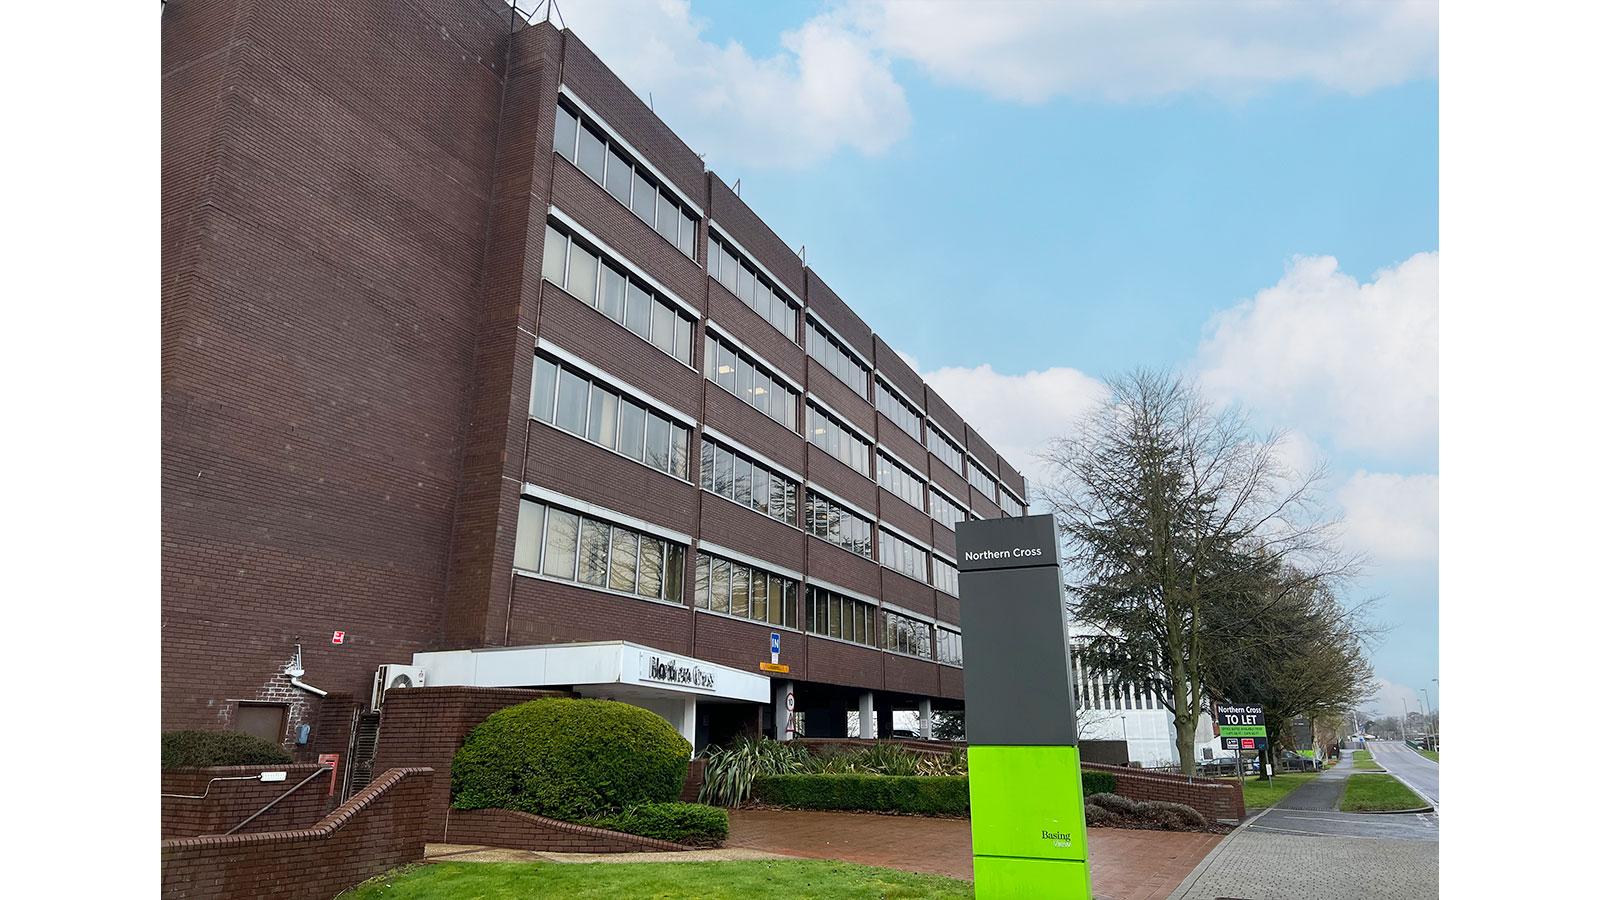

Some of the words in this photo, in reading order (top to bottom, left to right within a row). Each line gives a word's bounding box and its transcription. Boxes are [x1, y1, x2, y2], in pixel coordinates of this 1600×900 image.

[965, 550, 1010, 561] Northern
[1013, 548, 1042, 557] Cross
[1225, 715, 1239, 725] TO
[1241, 715, 1257, 725] LET
[1042, 830, 1071, 842] Basing
